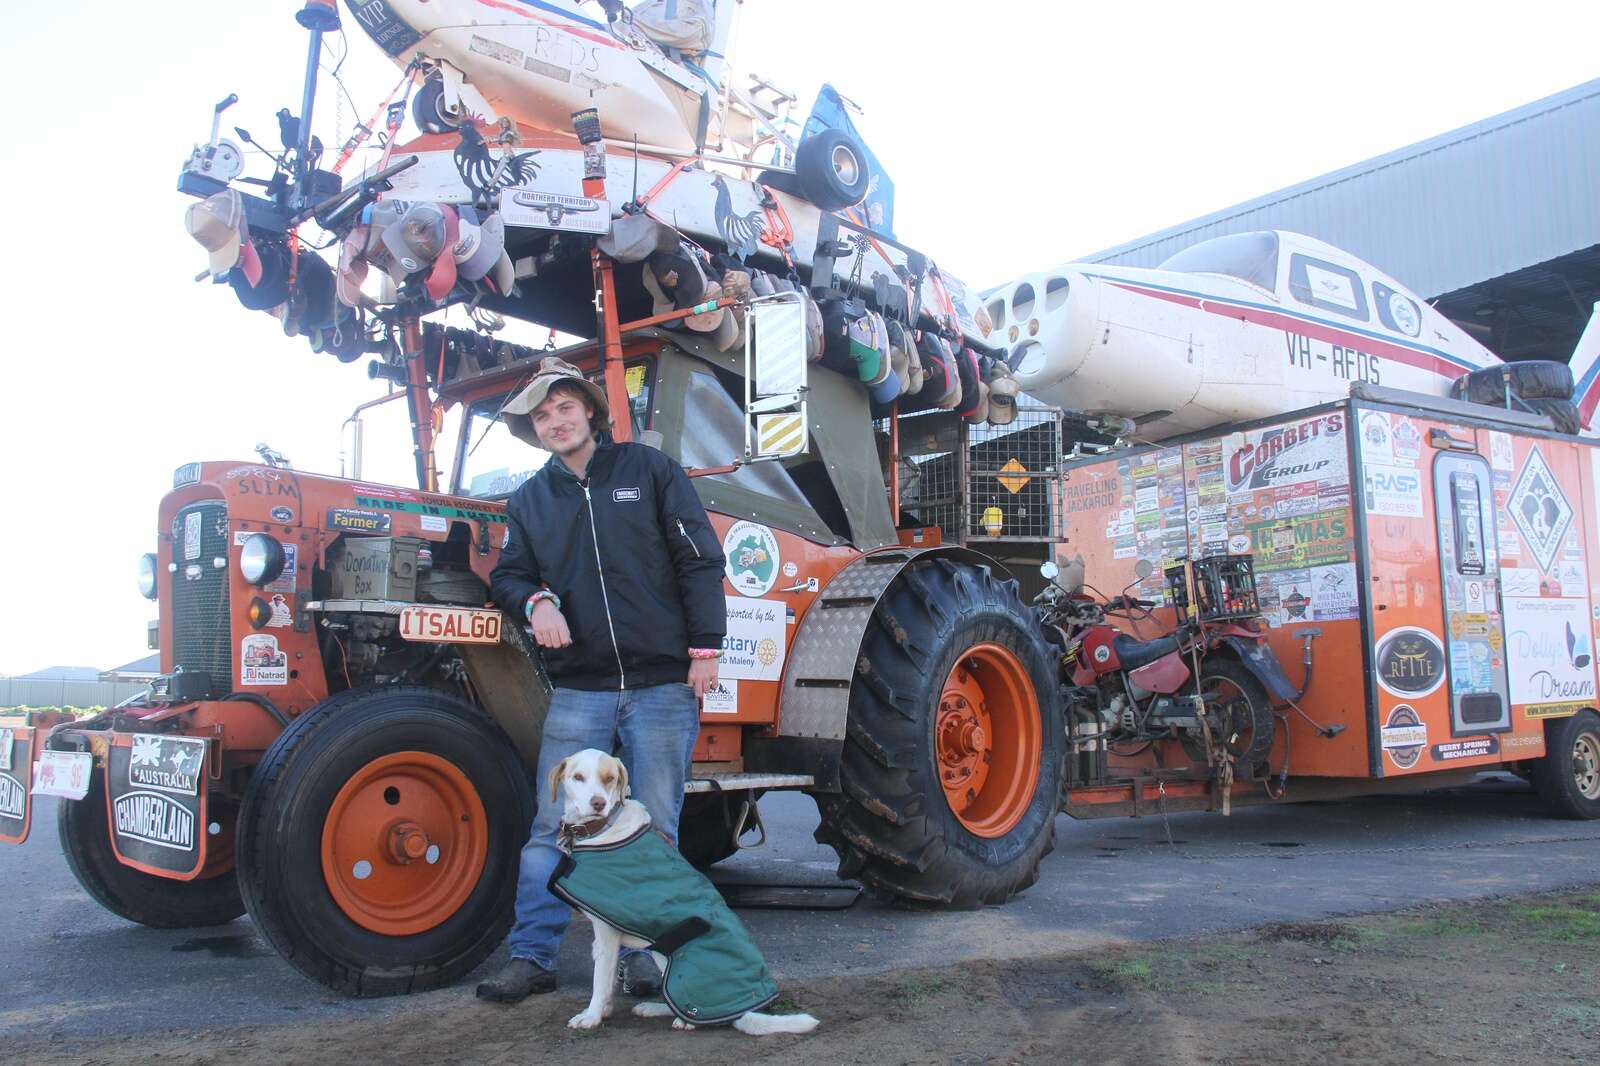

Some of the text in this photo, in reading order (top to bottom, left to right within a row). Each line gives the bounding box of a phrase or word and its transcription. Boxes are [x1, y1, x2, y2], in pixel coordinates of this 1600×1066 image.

[357, 1, 387, 28] VIP
[521, 192, 592, 207] NORTHERN TERRITORY
[1230, 415, 1343, 486] CORBET'S
[1264, 459, 1330, 480] GROUP
[239, 479, 297, 498] SLIM
[1375, 472, 1418, 493] RASP
[356, 496, 407, 511] MADE
[422, 504, 441, 516] IN
[456, 508, 508, 524] AUSTR
[333, 513, 379, 530] Farmer
[345, 551, 389, 573] Donation
[355, 575, 372, 595] Box
[403, 611, 499, 639] ITSALGO
[755, 608, 763, 624] by
[764, 608, 776, 622] the
[722, 635, 757, 655] otary
[719, 656, 755, 668] ub Maleny
[257, 668, 285, 679] Natrad
[1529, 670, 1594, 698] Dream
[1438, 740, 1491, 752] BERRY SPRINGS
[1442, 748, 1489, 759] MECHANICAL
[139, 769, 192, 790] AUSTRALIA
[117, 796, 191, 845] CHAMBERLAIN
